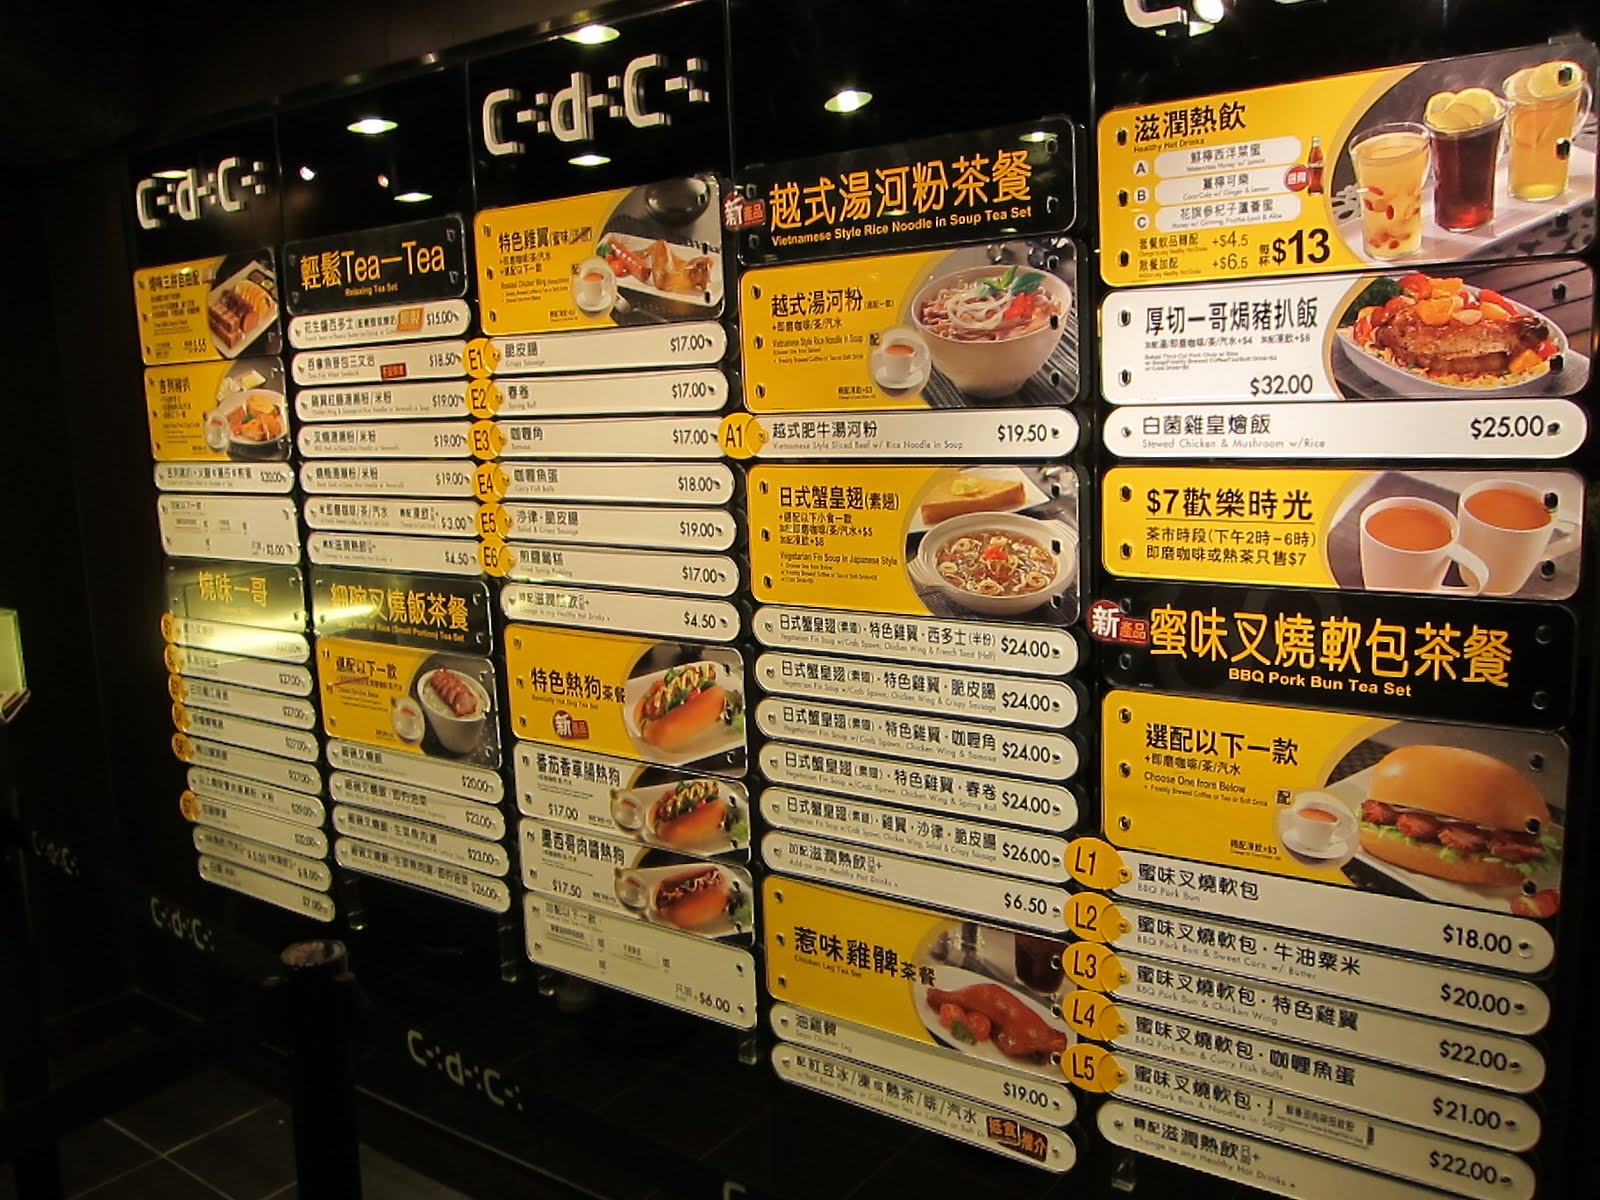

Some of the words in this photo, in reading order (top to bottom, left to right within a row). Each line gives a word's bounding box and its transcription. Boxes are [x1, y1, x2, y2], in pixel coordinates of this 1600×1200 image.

[1133, 101, 1247, 143] 滋潤熱飲
[1133, 142, 1163, 153] Healthy
[1164, 139, 1178, 149] Hot
[1179, 137, 1205, 147] Drinks
[770, 149, 1033, 231] 越式湯河粉茶餐
[771, 230, 832, 248] Vietnamese
[835, 225, 861, 241] Style
[864, 221, 889, 235] Rice
[891, 217, 932, 232] Noodle
[935, 214, 947, 227] in
[949, 212, 981, 228] Soup
[985, 207, 1007, 222] Tea
[1010, 205, 1033, 219] Set
[1271, 227, 1331, 267] $13
[771, 287, 863, 318] 越式湯河粉
[1146, 296, 1319, 337] 厚切一哥焗豬扒飯
[671, 334, 705, 352] $17.00
[468, 348, 483, 370] E1
[672, 382, 706, 399] $17.00
[1250, 374, 1313, 396] $32.00
[471, 388, 487, 409] E2
[672, 429, 709, 444] $17.00
[724, 424, 743, 449] A1
[772, 421, 878, 439] 越式肥牛湯河粉
[997, 424, 1047, 443] $19.50
[1142, 413, 1271, 436] 白菌雞皇燴飯
[1470, 415, 1544, 441] $25.00
[473, 430, 490, 451] E3
[1142, 438, 1175, 449] Stewed
[1179, 438, 1216, 449] Chicken
[1232, 437, 1284, 448] Mushroom
[478, 474, 493, 494] E4
[678, 476, 713, 491] $18.00
[481, 512, 496, 533] E5
[680, 521, 714, 537] $19.00
[483, 546, 499, 568] E6
[682, 565, 718, 583] $17.00
[684, 610, 716, 629] $4.50
[1001, 636, 1050, 659] $24.00
[1150, 603, 1512, 687] 蜜味叉燒軟包茶餐
[1228, 667, 1265, 684] BBQ
[1268, 672, 1305, 687] Pork
[1310, 675, 1344, 691] Bun
[1348, 678, 1378, 694] Tea
[1382, 681, 1412, 697] Set
[1002, 691, 1050, 714] $24.00
[1002, 741, 1050, 765] $24.00
[1145, 723, 1298, 766] 選配以下一款
[1144, 771, 1174, 785] Choose
[549, 804, 579, 821] $17.00
[1002, 791, 1050, 816] $24.00
[1002, 843, 1050, 867] $26.00
[1074, 845, 1097, 877] L1
[552, 880, 582, 899] $17.50
[1137, 862, 1260, 902] 蜜味叉燒軟包
[1159, 886, 1181, 899] Pork
[1183, 890, 1201, 902] Bun
[1003, 892, 1047, 917] $6.50
[1074, 902, 1098, 932] L2
[1442, 923, 1512, 956] $18.00
[1073, 950, 1097, 981] L3
[1159, 939, 1179, 952] Pork
[1181, 943, 1200, 954] Bun
[1243, 957, 1267, 971] Corn
[1440, 983, 1510, 1017] $20.00
[1072, 998, 1096, 1029] L4
[1072, 1052, 1095, 1082] L5
[1438, 1039, 1507, 1072] $22.00
[1003, 1080, 1048, 1108] $19.00
[1432, 1097, 1501, 1131] $21.00
[1429, 1151, 1498, 1186] $22.00
